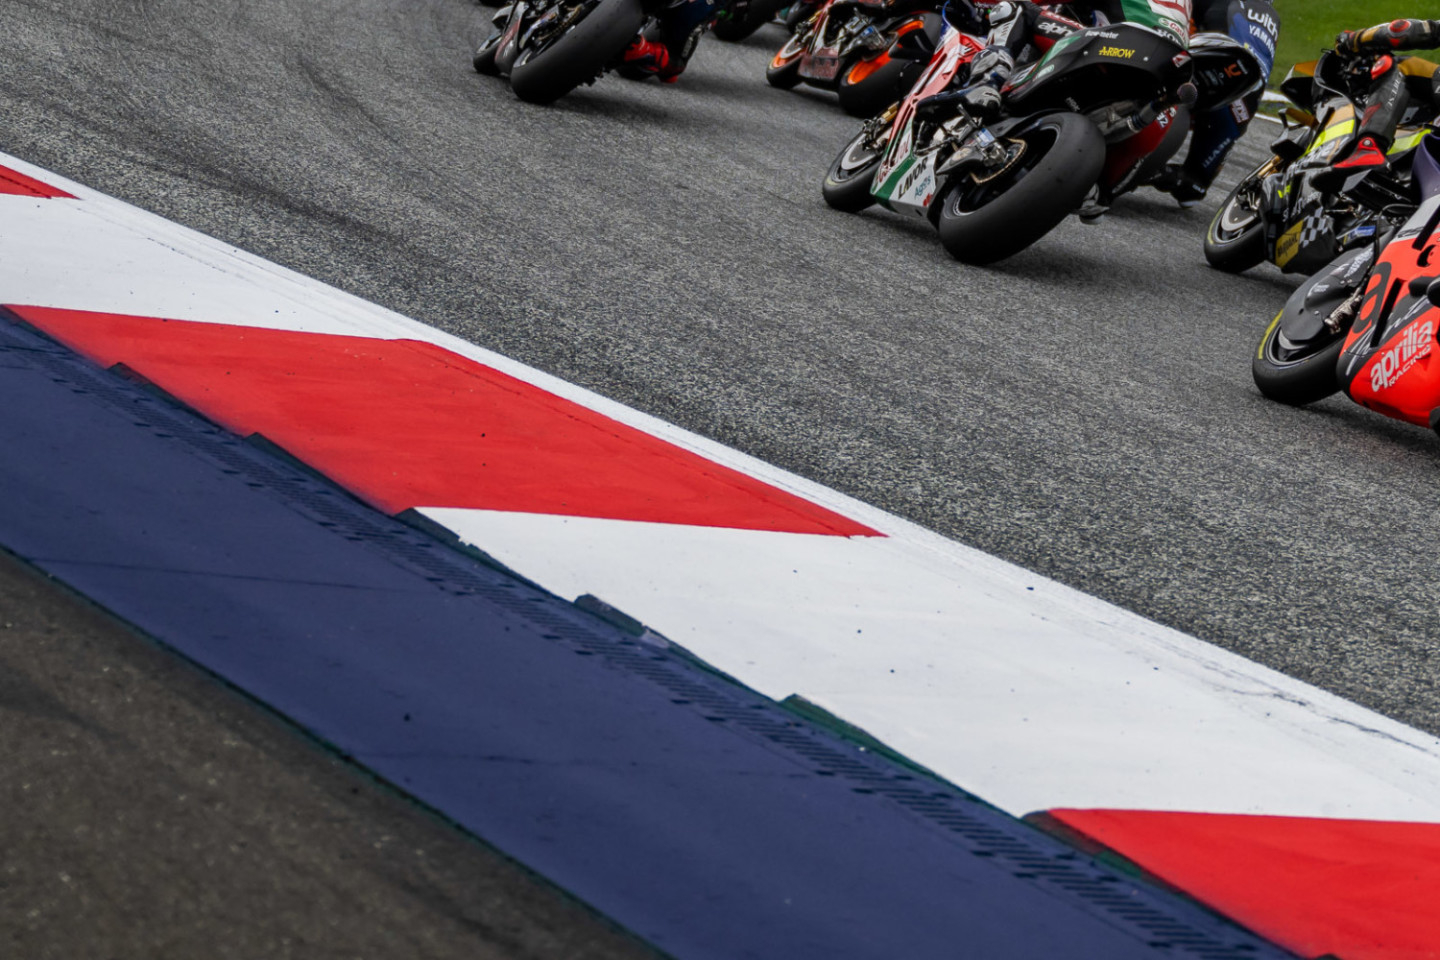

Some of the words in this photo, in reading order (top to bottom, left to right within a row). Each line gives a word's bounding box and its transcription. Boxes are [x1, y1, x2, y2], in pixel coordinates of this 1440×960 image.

[1247, 9, 1279, 41] with
[1098, 45, 1136, 59] ARROW
[1371, 320, 1433, 392] aprilia
[1389, 344, 1432, 387] RACING
